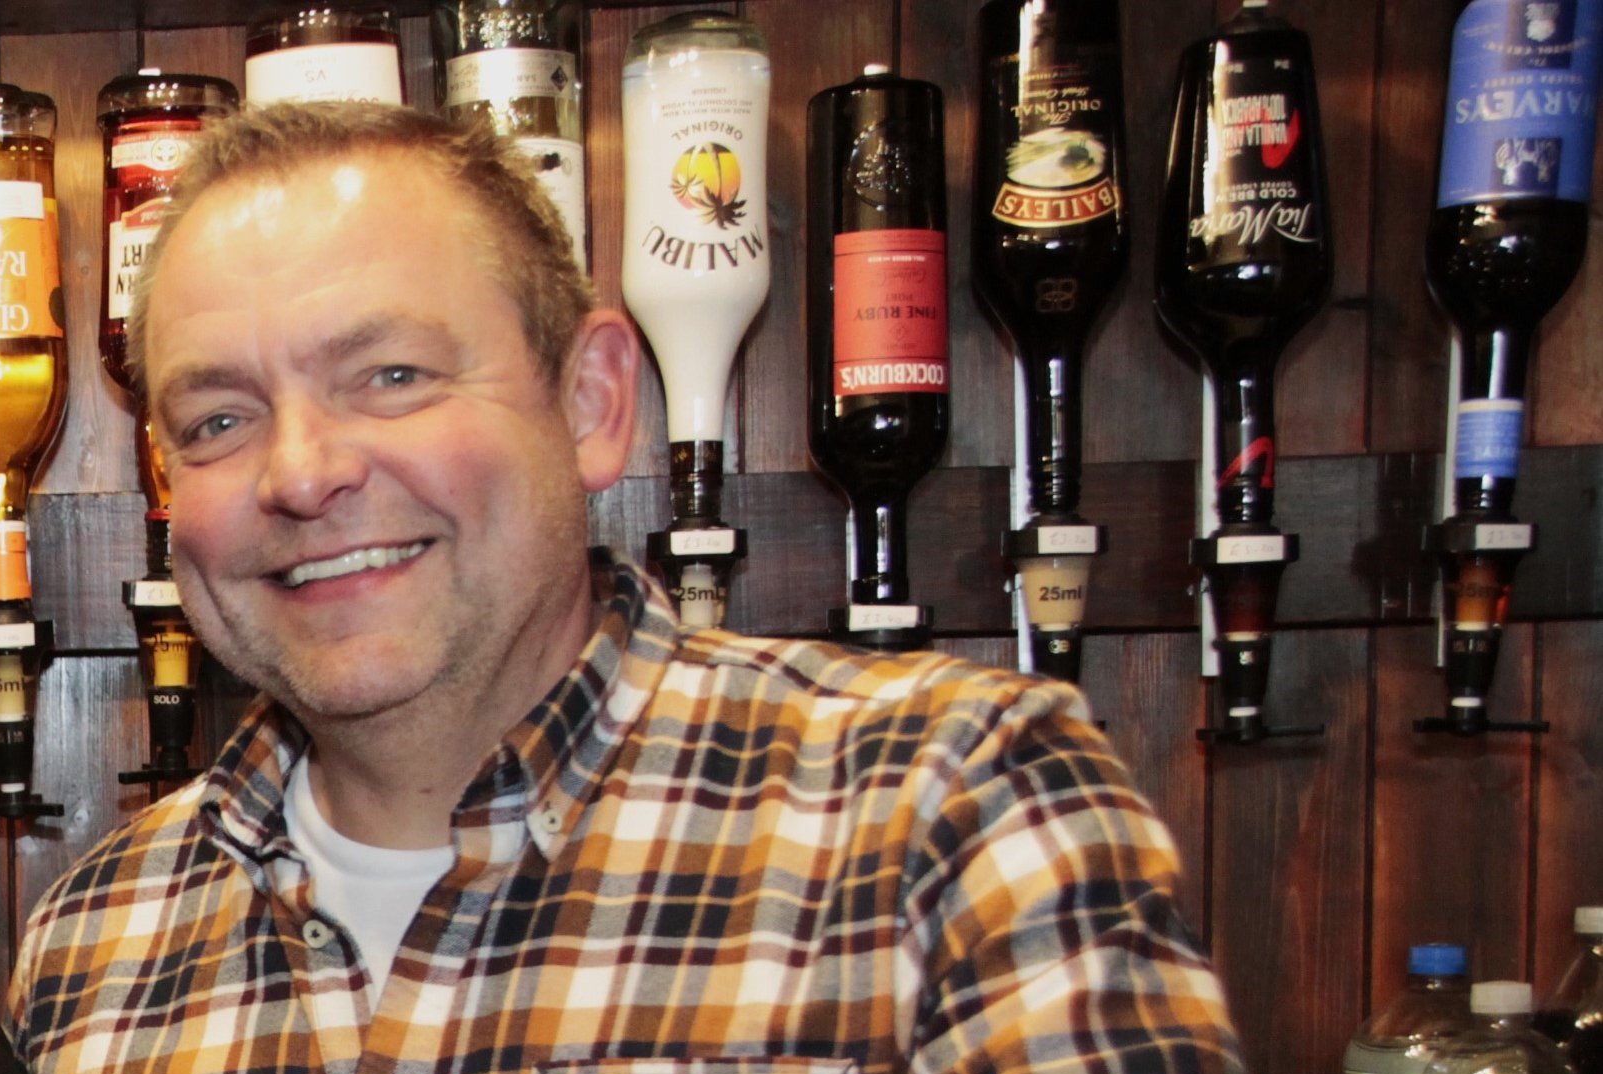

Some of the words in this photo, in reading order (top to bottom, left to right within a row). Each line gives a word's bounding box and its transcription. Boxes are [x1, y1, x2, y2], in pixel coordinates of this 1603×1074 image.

[1011, 99, 1101, 118] ORIGINAL
[671, 120, 744, 142] ORIGINAL
[1259, 187, 1297, 199] COLD
[999, 186, 1113, 220] BAILEYS
[642, 224, 764, 271] MALIBU
[854, 305, 901, 320] RUBY
[906, 305, 937, 319] FINE
[839, 363, 945, 390] COCKBURN'S
[679, 586, 719, 601] 25ml
[1039, 585, 1082, 601] 25ml
[153, 694, 180, 705] SOLO
